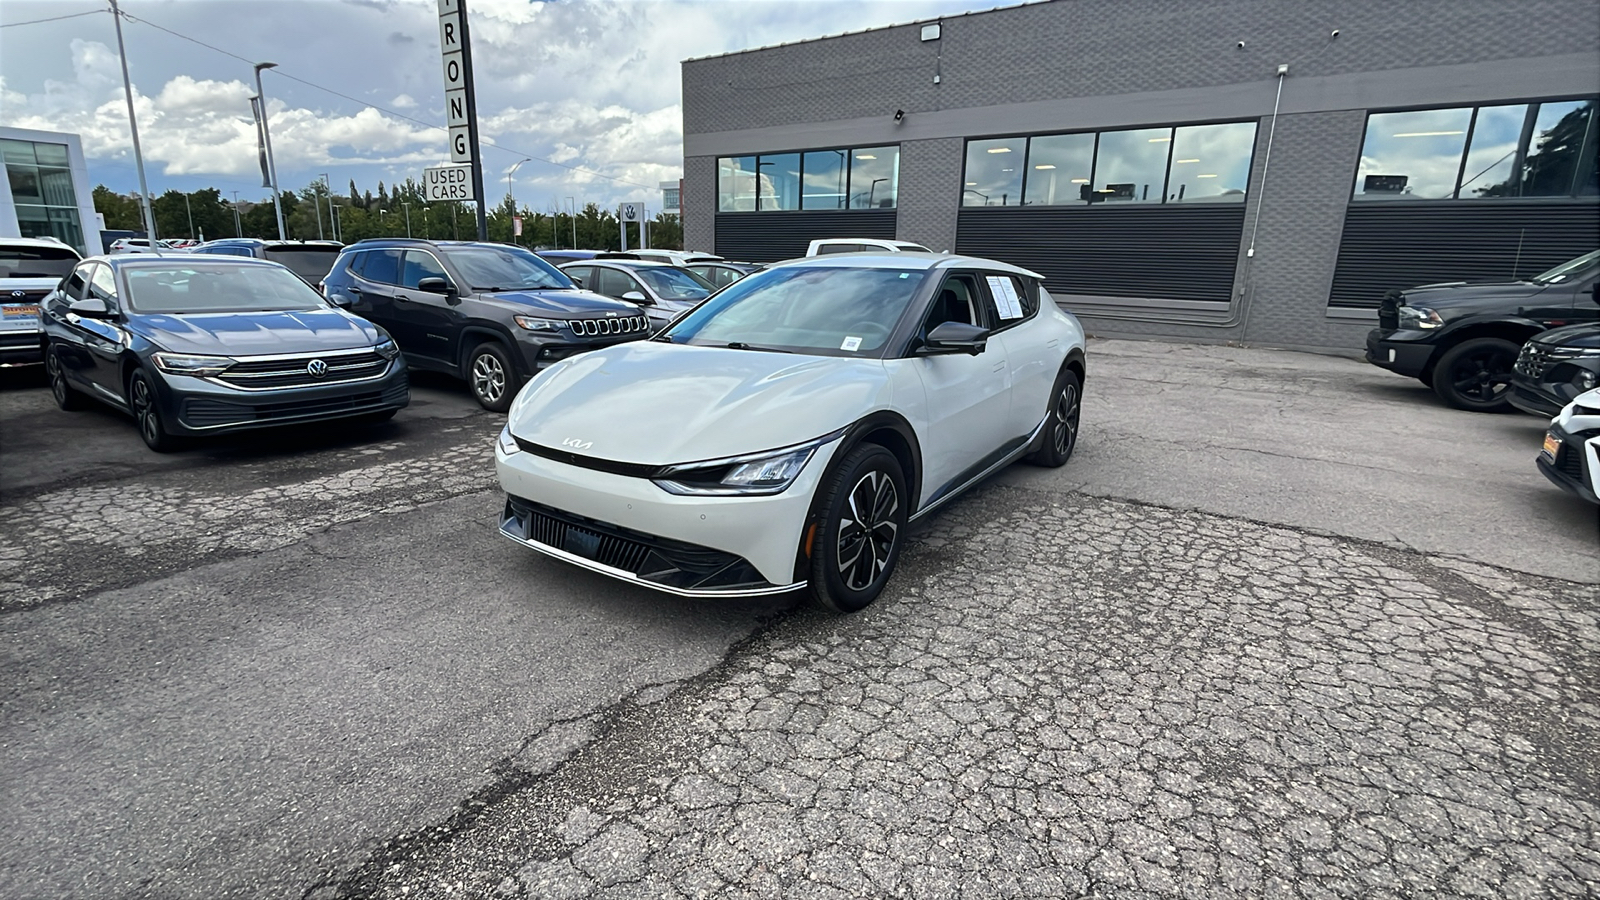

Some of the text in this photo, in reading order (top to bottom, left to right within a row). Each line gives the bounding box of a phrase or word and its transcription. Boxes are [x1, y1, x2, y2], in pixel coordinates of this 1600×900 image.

[444, 0, 466, 155] RONG
[430, 169, 466, 184] USED
[432, 184, 467, 199] CARS
